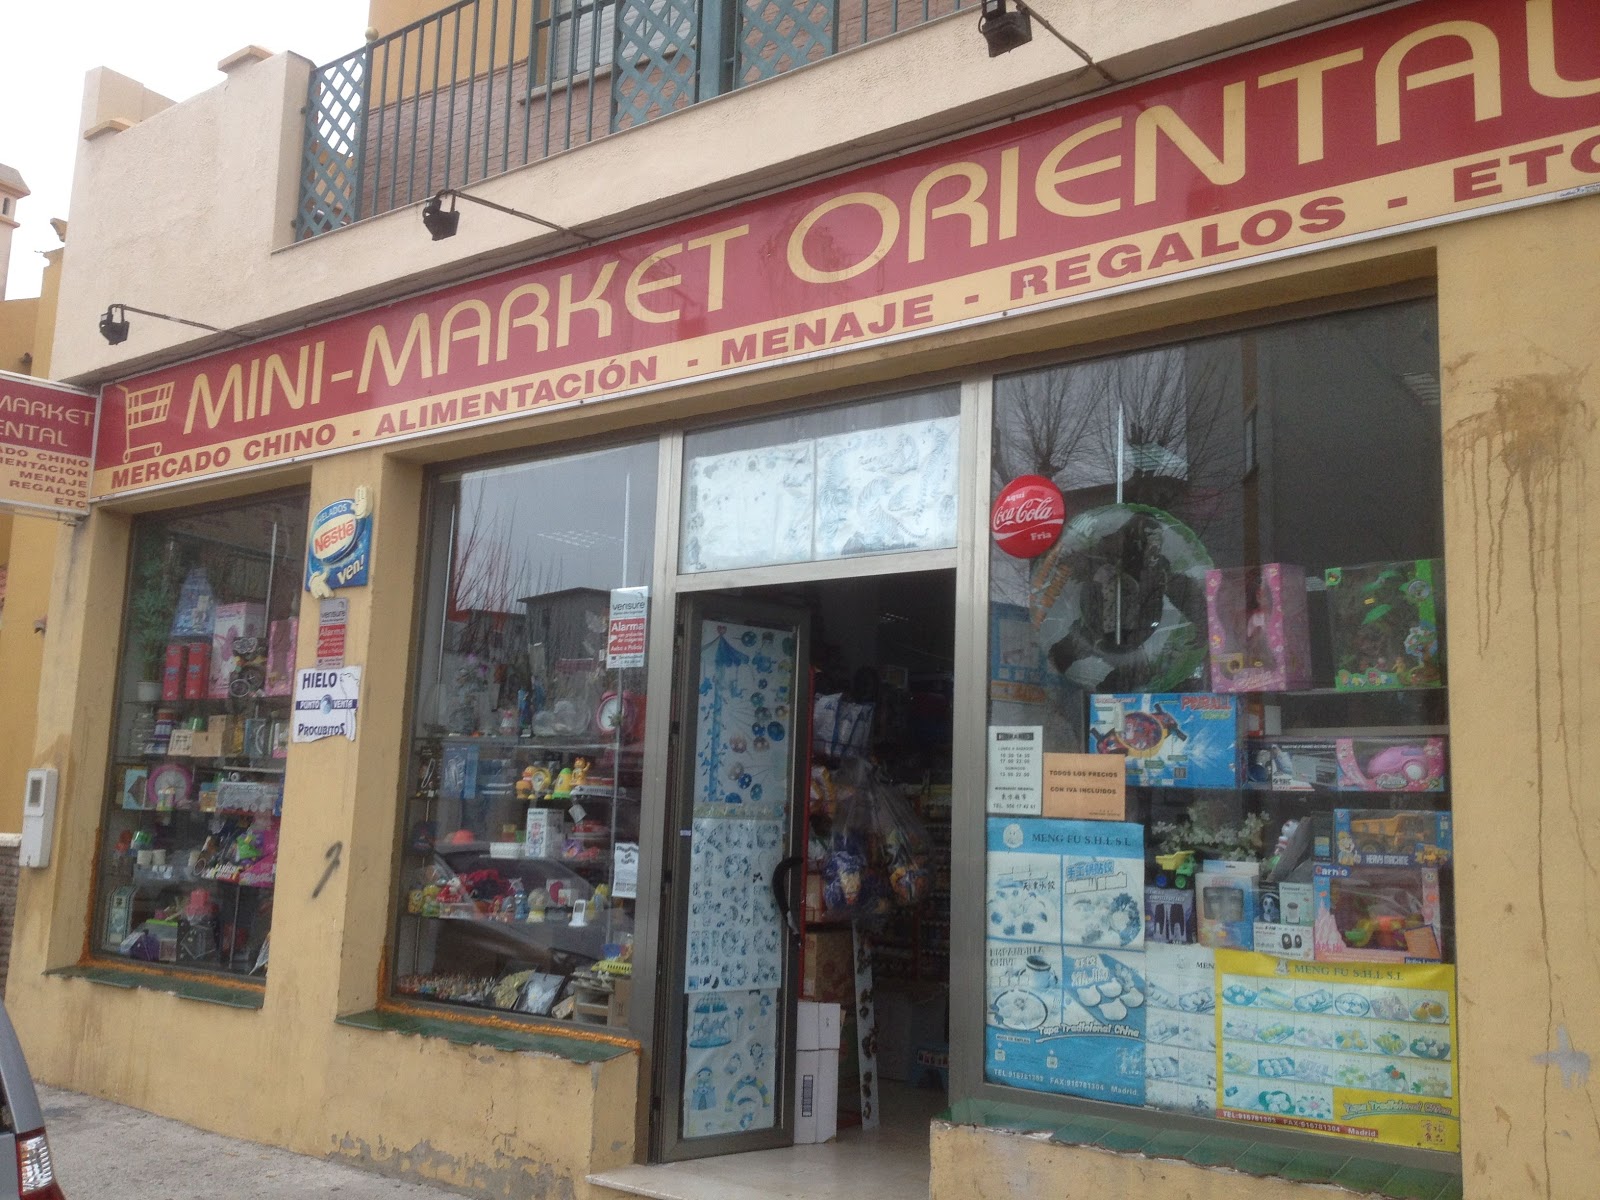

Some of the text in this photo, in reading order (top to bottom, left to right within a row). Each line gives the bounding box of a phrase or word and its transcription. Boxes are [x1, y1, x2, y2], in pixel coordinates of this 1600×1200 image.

[183, 0, 1600, 435] MINI-MARKET ORIENTAL
[111, 445, 230, 490] MERCADO
[243, 423, 336, 460] CHINO
[375, 356, 658, 436] ALIMENTACIÓN
[721, 294, 934, 366] MENAJE
[1010, 196, 1346, 300] REGALOS
[36, 453, 89, 467] CHINO
[19, 470, 87, 488] MENAJE
[9, 479, 87, 498] REGALOS
[54, 497, 86, 509] ETC
[337, 554, 365, 585] ven!
[611, 622, 644, 632] Alarma
[302, 672, 338, 690] HIELO
[1032, 834, 1063, 843] MENG
[1197, 961, 1214, 969] MEN
[1294, 965, 1329, 976] MENG
[1111, 1085, 1138, 1096] Madrid
[1348, 1127, 1376, 1138] Madrid
